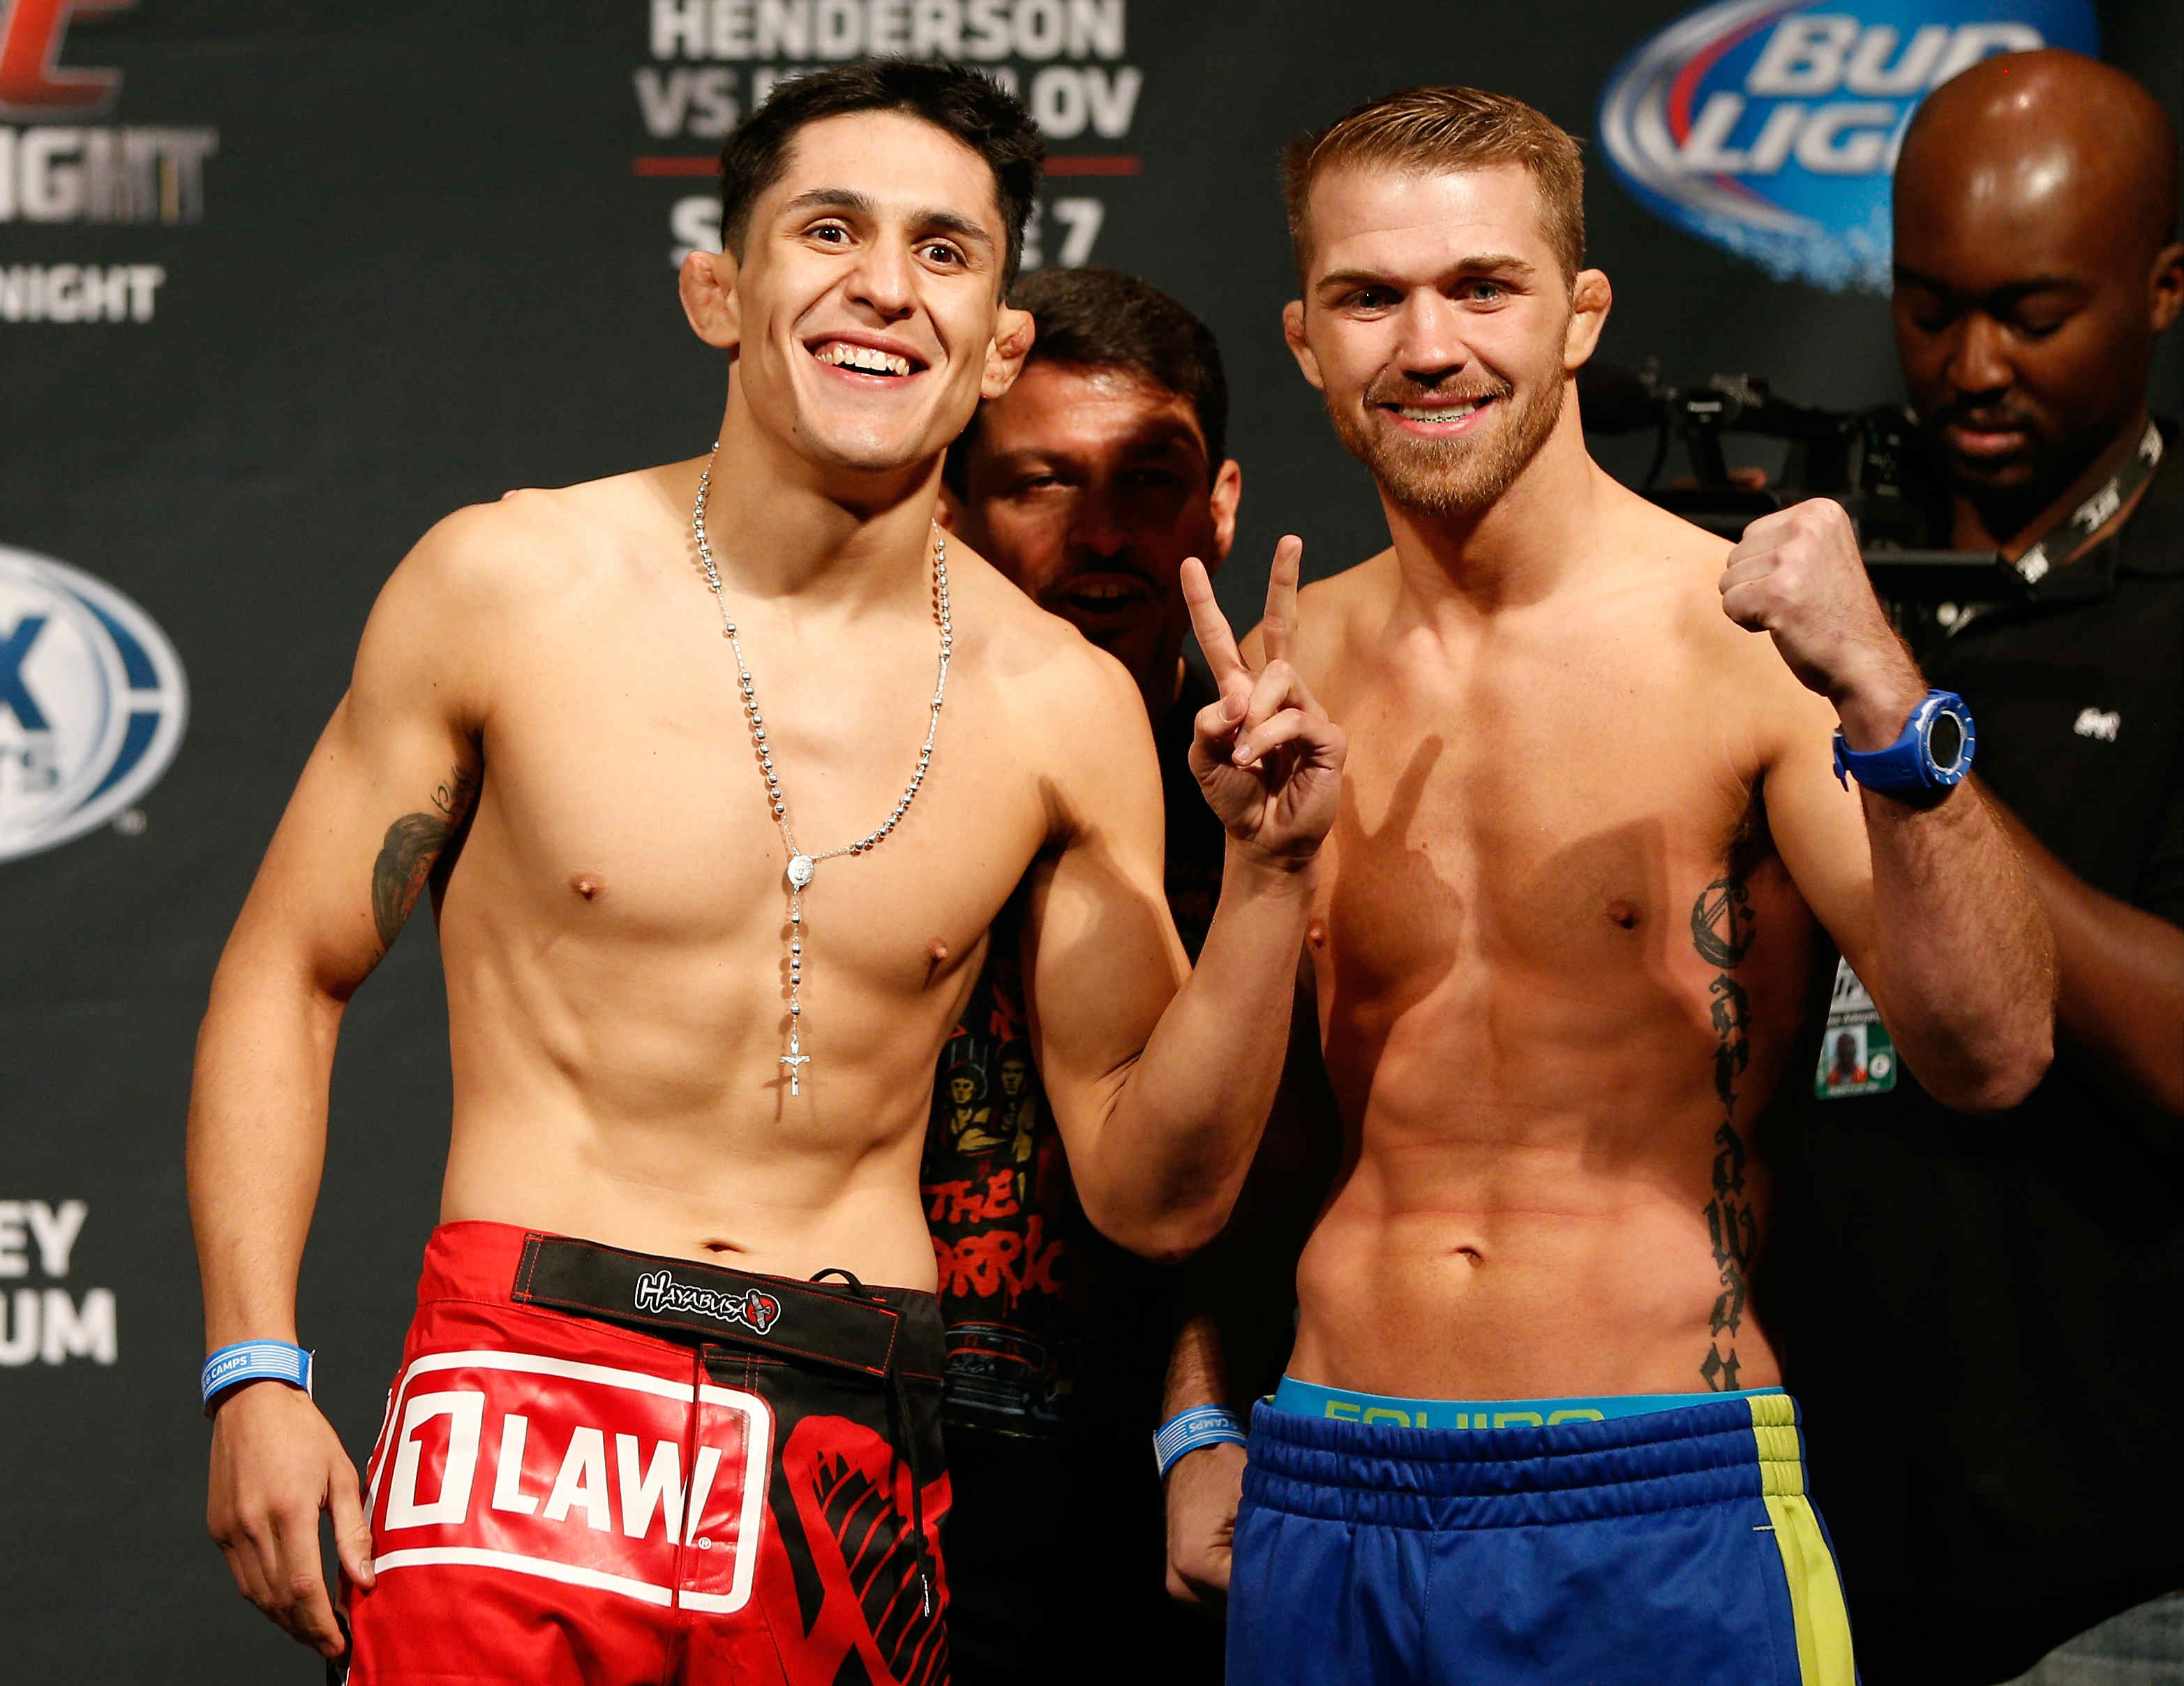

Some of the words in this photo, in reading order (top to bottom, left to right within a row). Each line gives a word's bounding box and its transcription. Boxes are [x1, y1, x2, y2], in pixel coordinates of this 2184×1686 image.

[650, 0, 1125, 61] HENDERSON
[634, 68, 741, 138] VS
[1678, 92, 1917, 176] LIG
[0, 1288, 118, 1366] UM
[211, 1355, 248, 1380] CAMPS
[1188, 1417, 1229, 1433] CAMPS
[492, 1413, 721, 1547] LAW
